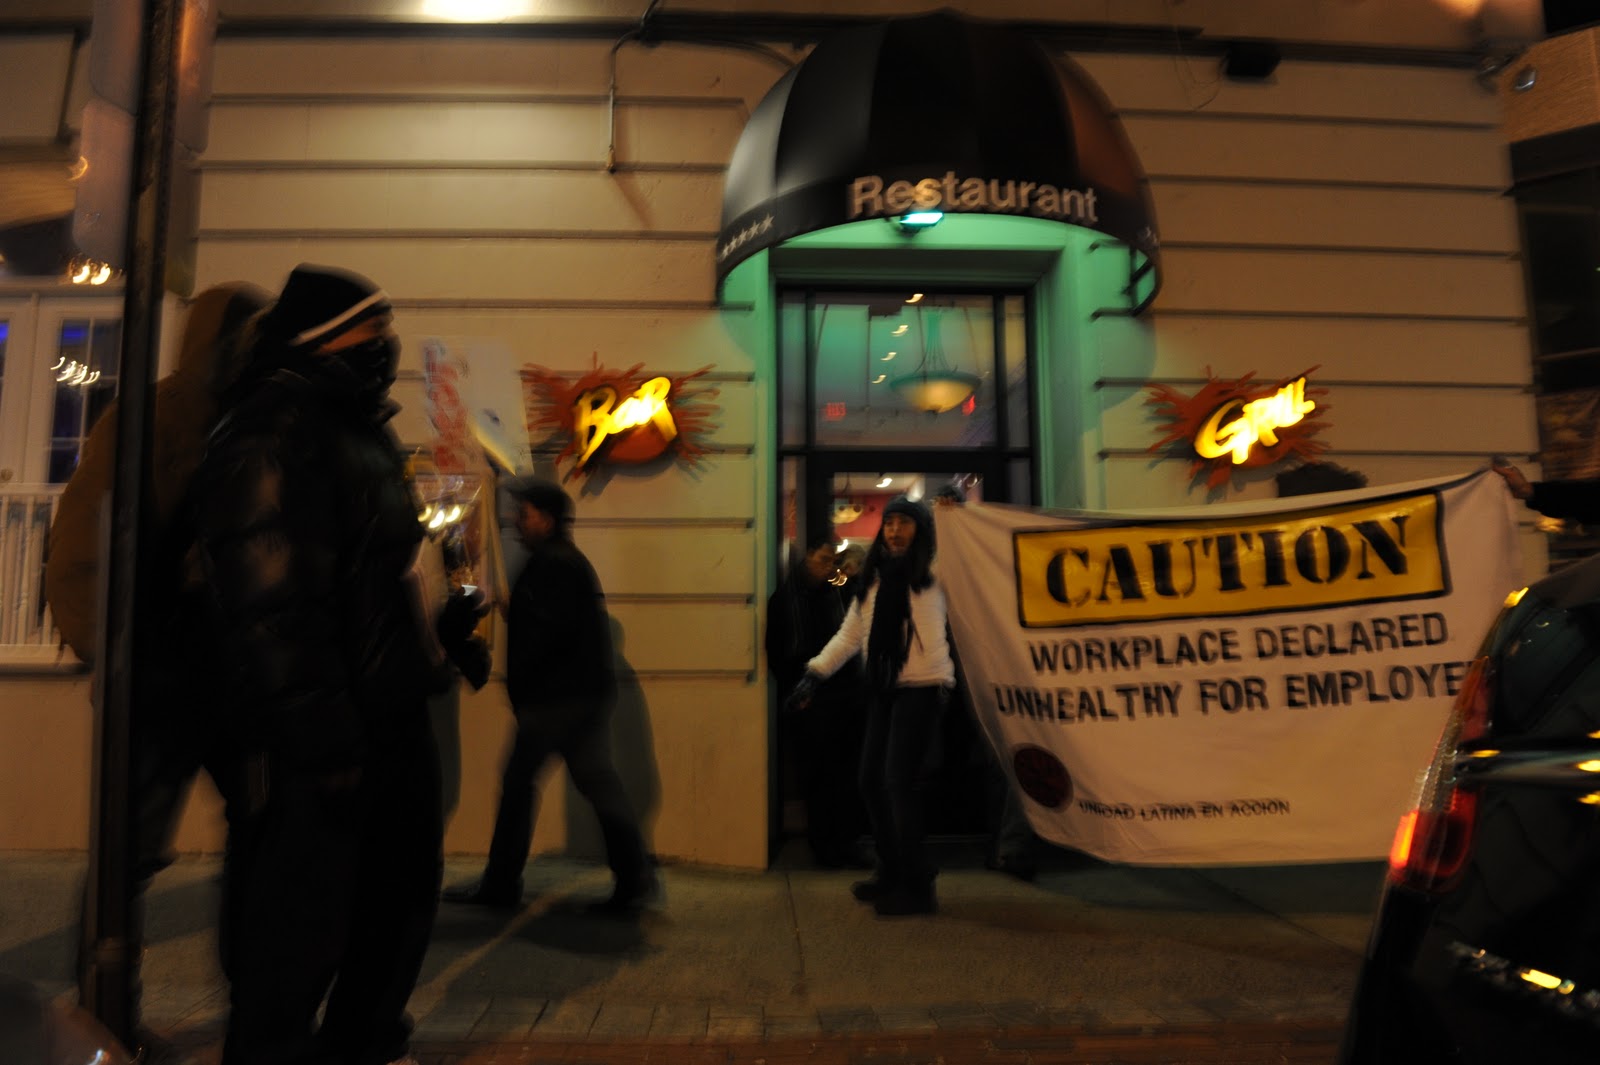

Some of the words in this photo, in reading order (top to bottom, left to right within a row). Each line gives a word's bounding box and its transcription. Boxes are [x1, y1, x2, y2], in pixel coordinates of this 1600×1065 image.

[847, 170, 1099, 223] Restaurant
[1046, 514, 1410, 608] CAUTION
[1030, 627, 1241, 675] WORKPLACE
[1255, 611, 1448, 662] DECLARED
[995, 683, 1182, 721] UNHEALTHY
[1200, 676, 1270, 713] FOR
[1285, 660, 1474, 708] EMPLOYE
[1140, 802, 1197, 821] LATINA
[1202, 802, 1224, 818] EN
